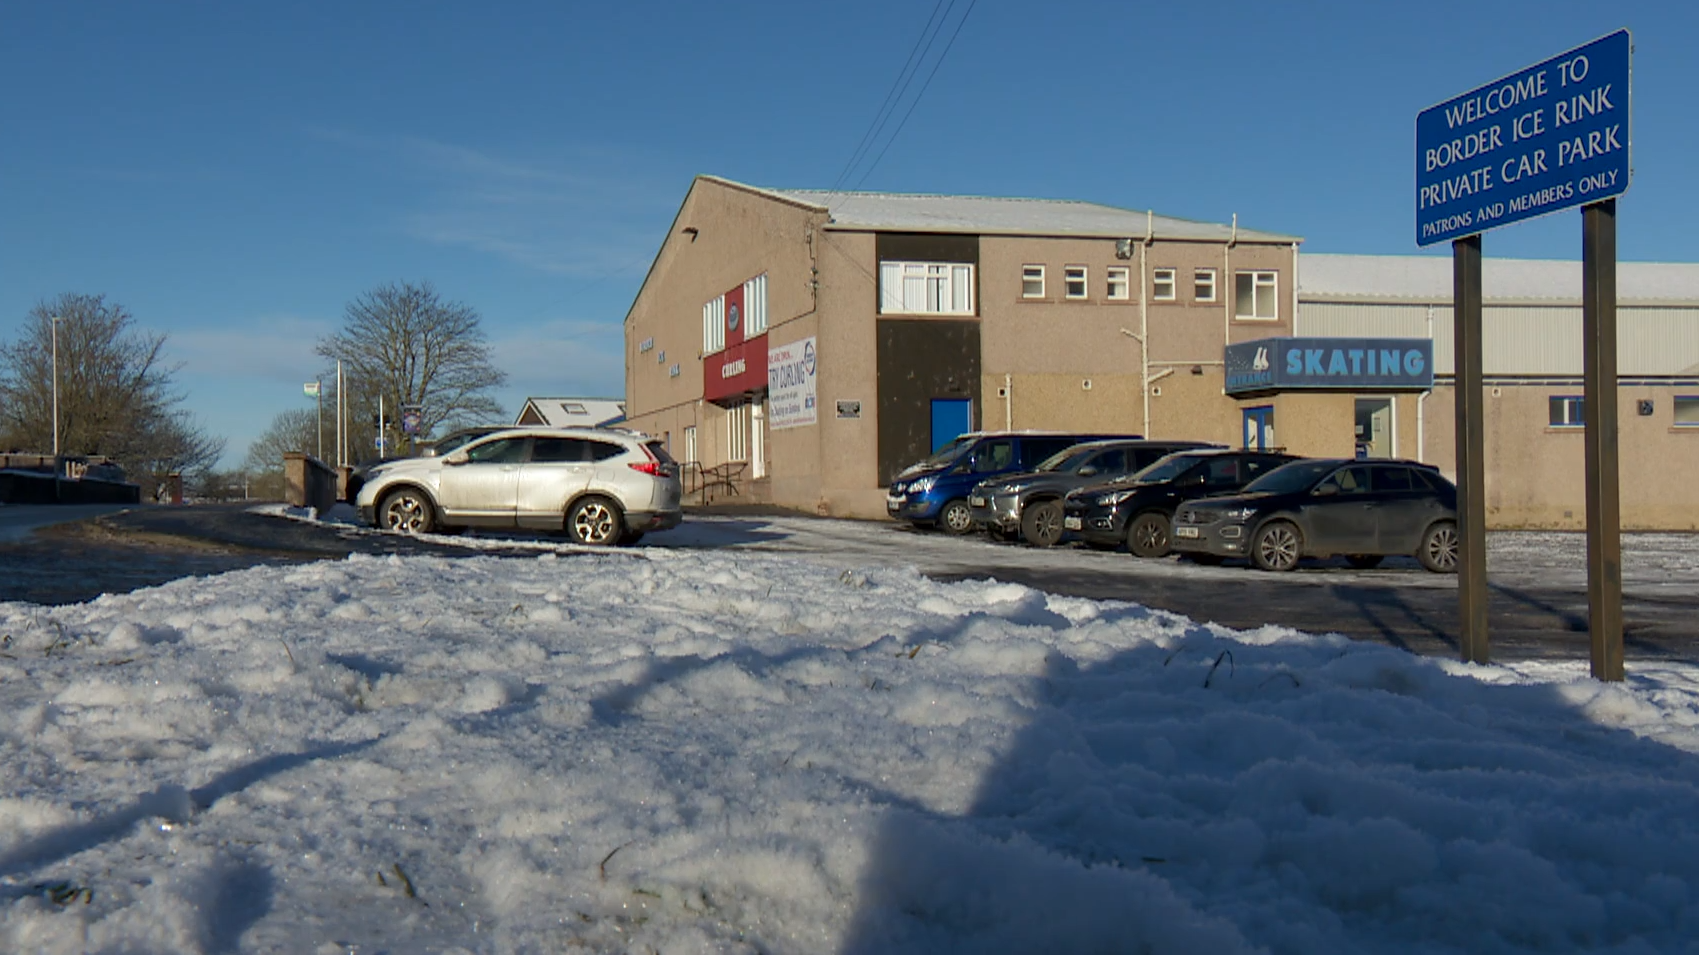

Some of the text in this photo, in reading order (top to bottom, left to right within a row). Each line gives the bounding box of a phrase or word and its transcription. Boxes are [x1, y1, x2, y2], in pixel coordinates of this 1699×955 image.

[1445, 55, 1589, 129] WELCOME TO
[1425, 84, 1614, 172] BORDER ICE RINK
[1420, 124, 1622, 210] PRIVATE CAR PARK
[1422, 169, 1618, 238] PATRONS AND MEMBERS ONLY
[722, 358, 746, 380] CURLING
[769, 360, 805, 390] TRY CURLING
[1286, 348, 1425, 377] SKATING
